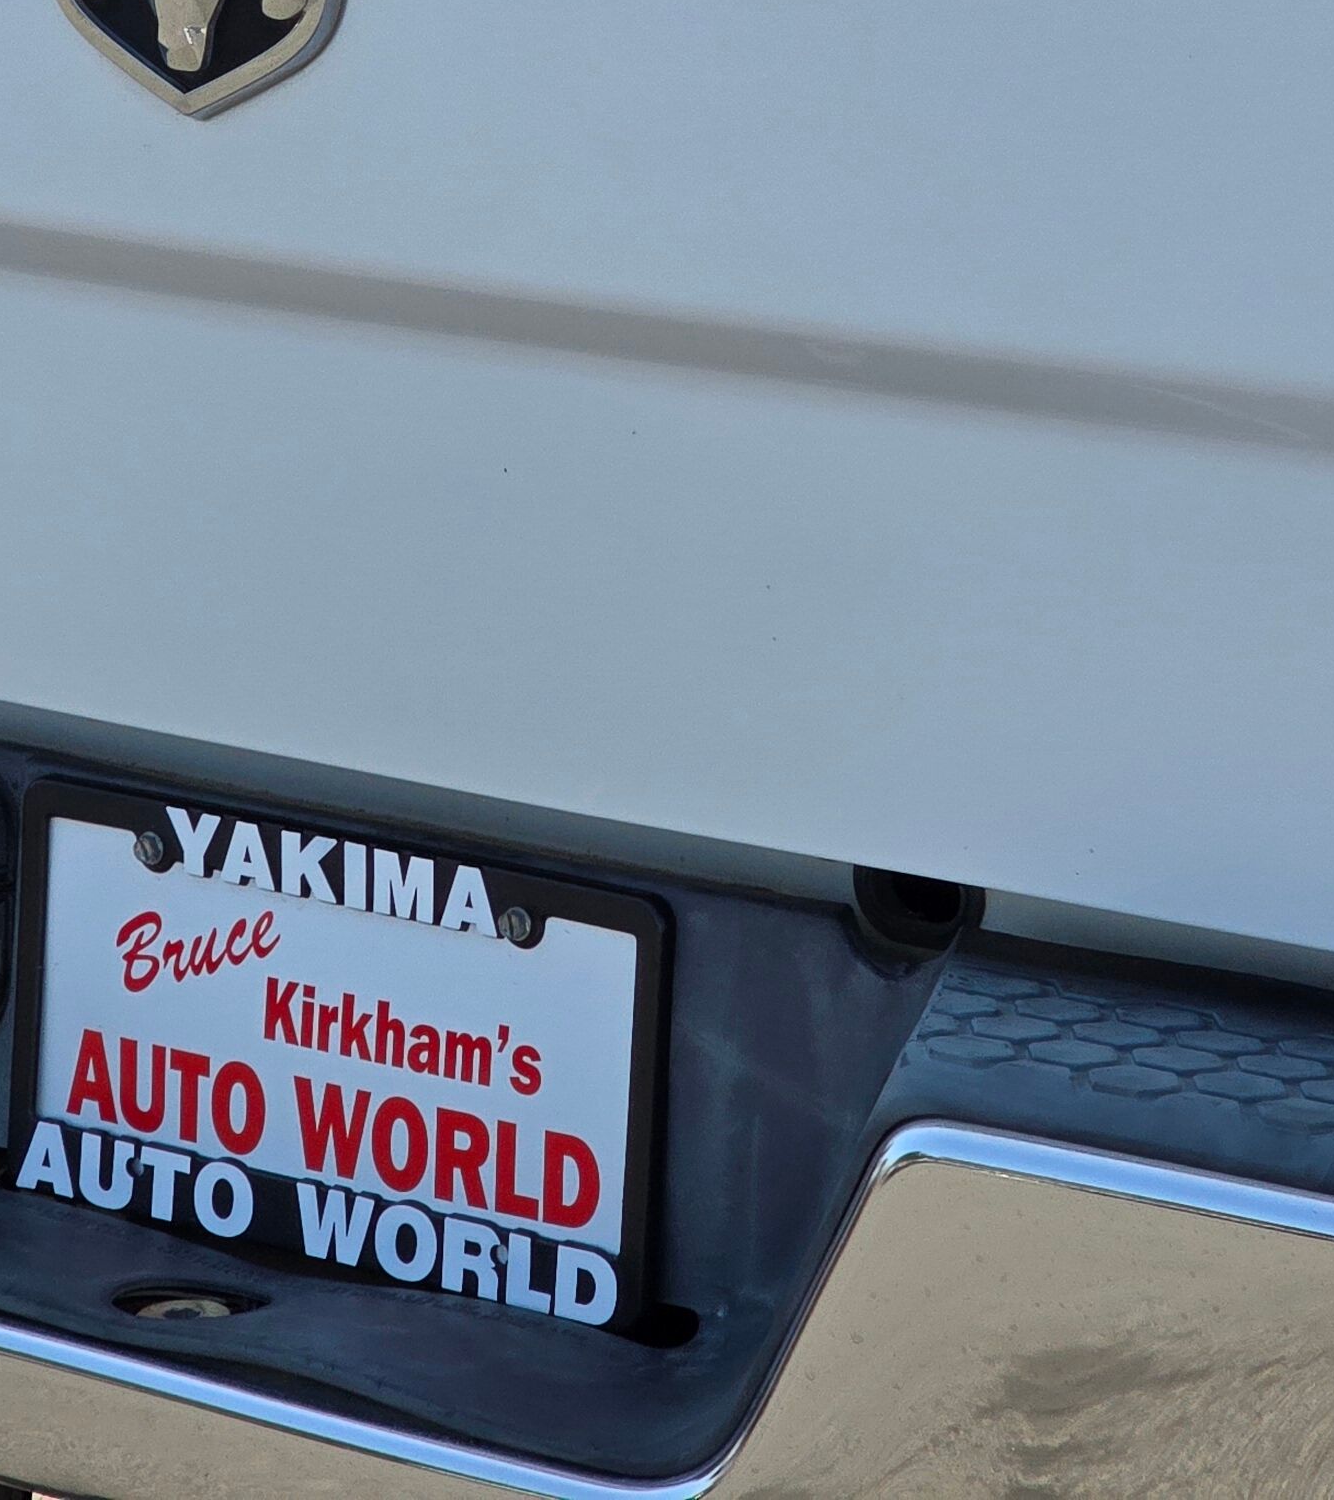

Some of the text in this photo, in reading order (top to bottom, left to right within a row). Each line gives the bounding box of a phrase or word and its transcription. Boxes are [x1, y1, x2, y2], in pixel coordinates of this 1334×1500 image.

[116, 911, 280, 992] Bruce
[166, 806, 499, 939] YAKIMA
[66, 1029, 601, 1229] AUTO WORLD
[16, 1121, 619, 1326] AUTO WORLD
